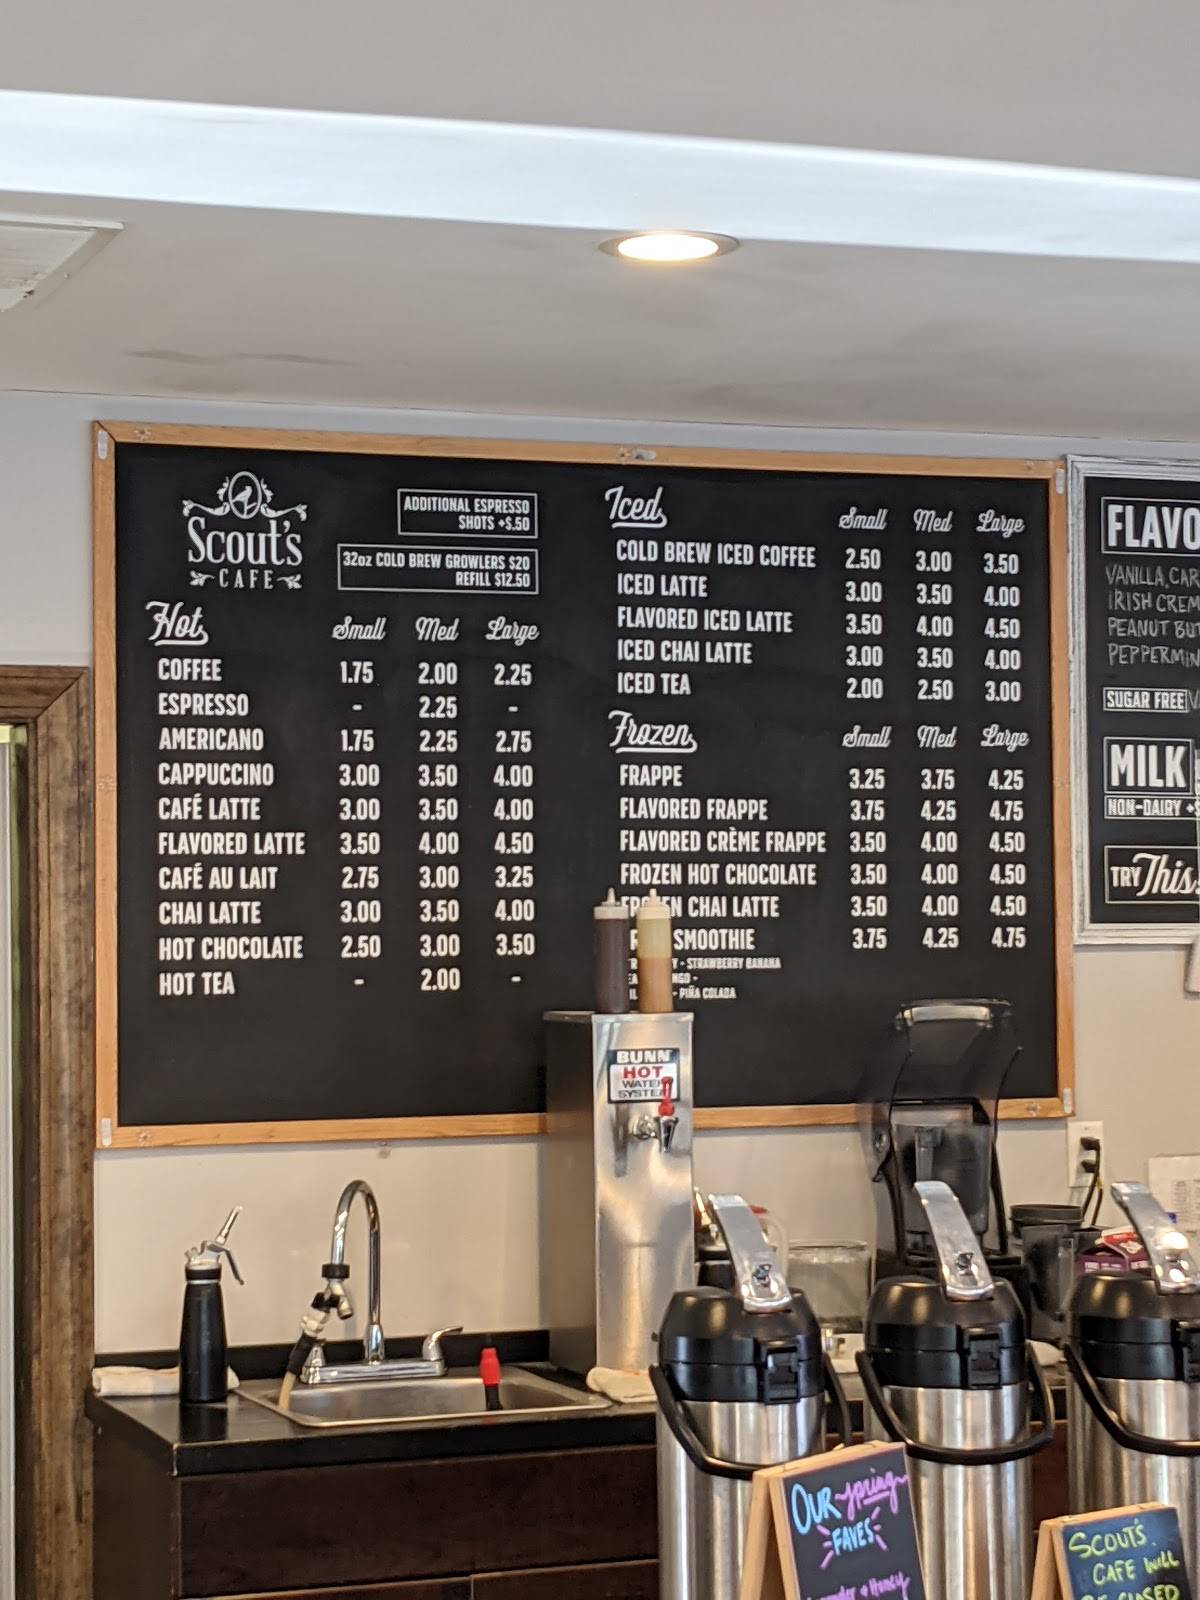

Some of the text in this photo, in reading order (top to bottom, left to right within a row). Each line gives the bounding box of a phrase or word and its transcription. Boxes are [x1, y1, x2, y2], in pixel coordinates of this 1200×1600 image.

[404, 496, 529, 514] ADDITIONAL ESPRESSO
[605, 486, 667, 528] Iced
[459, 515, 530, 531] SHOTS +$.50
[839, 507, 1024, 538] Small Med Large
[188, 516, 302, 565] Scout's
[343, 551, 530, 570] 32oz COLD BREW GROWLERS $20
[617, 539, 1018, 574] COLD BREW ICED COFFEE 2.50 3.00 3.50
[219, 568, 273, 589] CAFE
[456, 571, 530, 587] REFILL $12.50
[618, 573, 1020, 607] ICED LATTE 3.00 3.50 4.00
[146, 601, 208, 646] Hot
[332, 616, 539, 646] Small Med Large
[618, 606, 1020, 639] FLAVORED ICED LATTE 3.50 4.00 4.50
[1108, 617, 1170, 637] PEANUT
[618, 639, 1020, 670] ICED CHAI LATTE 3.00 3.50 4.00
[159, 658, 531, 685] COFFEE 1.75 2.00 2.25
[618, 672, 1020, 701] ICED TEA 2.00 2.50 3.00
[159, 693, 457, 718] ESPRESSO 2.25
[1107, 691, 1184, 710] SUGAR FREE
[159, 728, 531, 752] AMERICANO 1.75 2.25 2.75
[608, 710, 697, 753] Frozen
[842, 724, 1029, 752] Small Med Large
[159, 763, 533, 787] CAPPUCCINO 3.00 3.50 4.00
[620, 764, 1023, 790] FRAPPE 3.25 3.75 4.25
[1111, 744, 1186, 787] MILK
[159, 793, 533, 820] CAFÉ LATTE 3.00 3.50 4.00
[620, 797, 1023, 821] FLAVORED FRAPPE 3.75 4.25 4.75
[1108, 799, 1181, 816] NON-DAIRY
[159, 832, 533, 854] FLAVORED LATTE 3.50 4.00 4.50
[621, 827, 1025, 852] FLAVORED CRÈME FRAPPE 3.50 4.00 4.50
[159, 863, 533, 889] CAFÉ AU LAIT 2.75 3.00 3.25
[621, 863, 1025, 885] FROZEN HOT CHOCOLATE 3.50 4.00 4.50
[1110, 867, 1142, 887] TRY
[159, 899, 534, 925] CHAI LATTE 3.00 3.50 4.00
[688, 895, 1026, 917] CHAI LATTE 3.50 4.00 4.50
[159, 933, 535, 960] HOT CHOCOLATE 2.50 3.00 3.50
[673, 927, 1026, 950] SMOOTHIE 3.75 4.25 4.75
[687, 958, 744, 969] STRAWBERRY
[160, 968, 460, 995] HOT TEA 2.00
[703, 987, 736, 999] COLADA
[617, 1050, 672, 1064] BUNN
[624, 1066, 663, 1078] HOT
[792, 1484, 842, 1534] OUR
[832, 1517, 874, 1555] FAVES
[1093, 1559, 1136, 1586] CAFE
